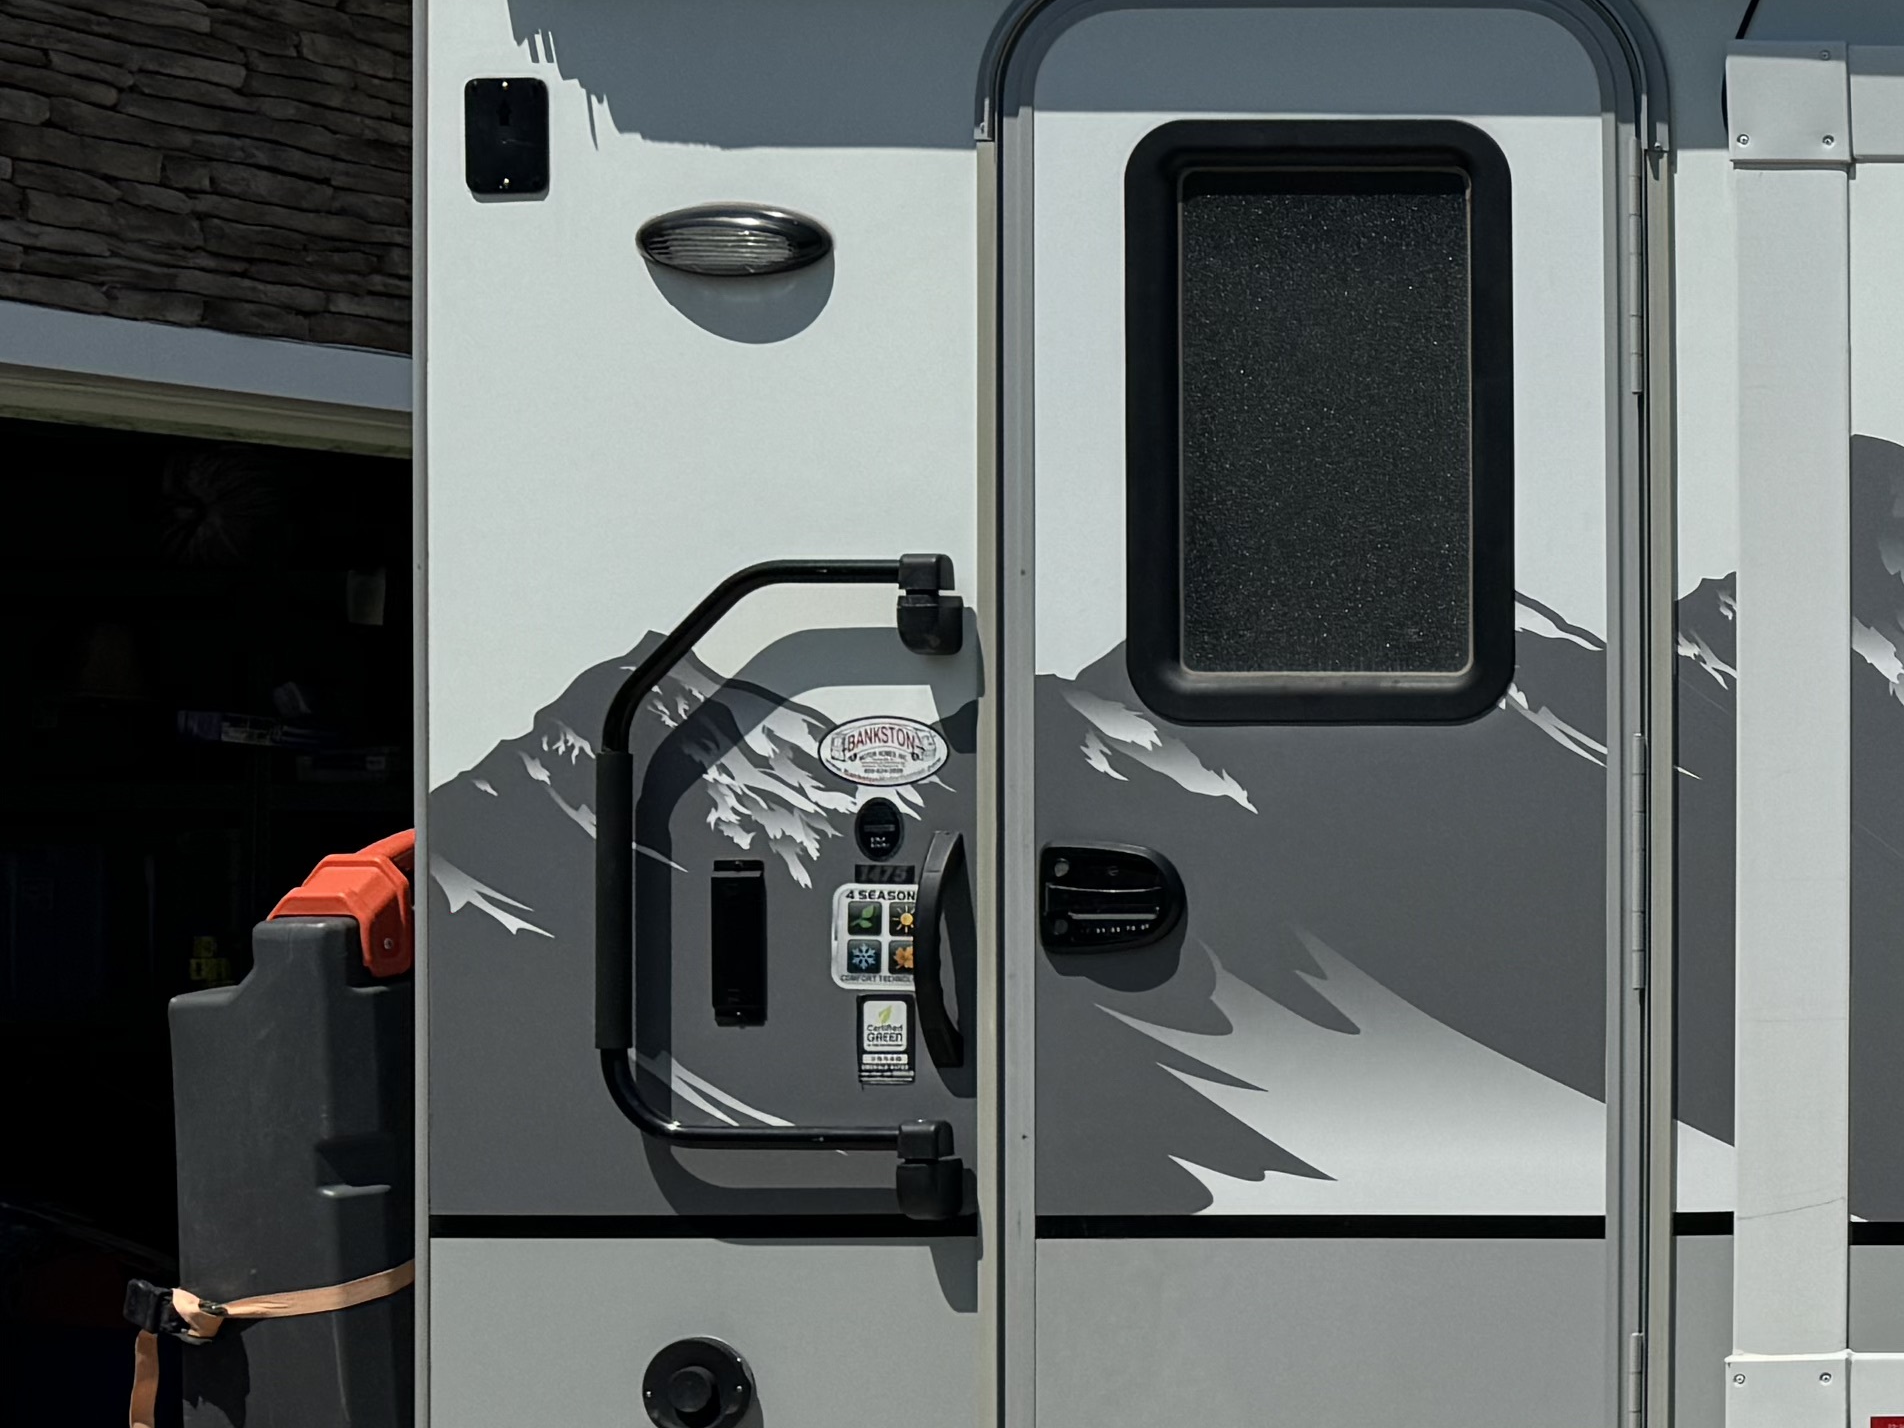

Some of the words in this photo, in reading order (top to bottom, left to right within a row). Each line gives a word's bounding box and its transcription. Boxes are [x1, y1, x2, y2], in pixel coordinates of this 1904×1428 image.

[847, 725, 915, 753] BANKSTON
[846, 889, 855, 900] 4
[858, 890, 916, 901] SEASON
